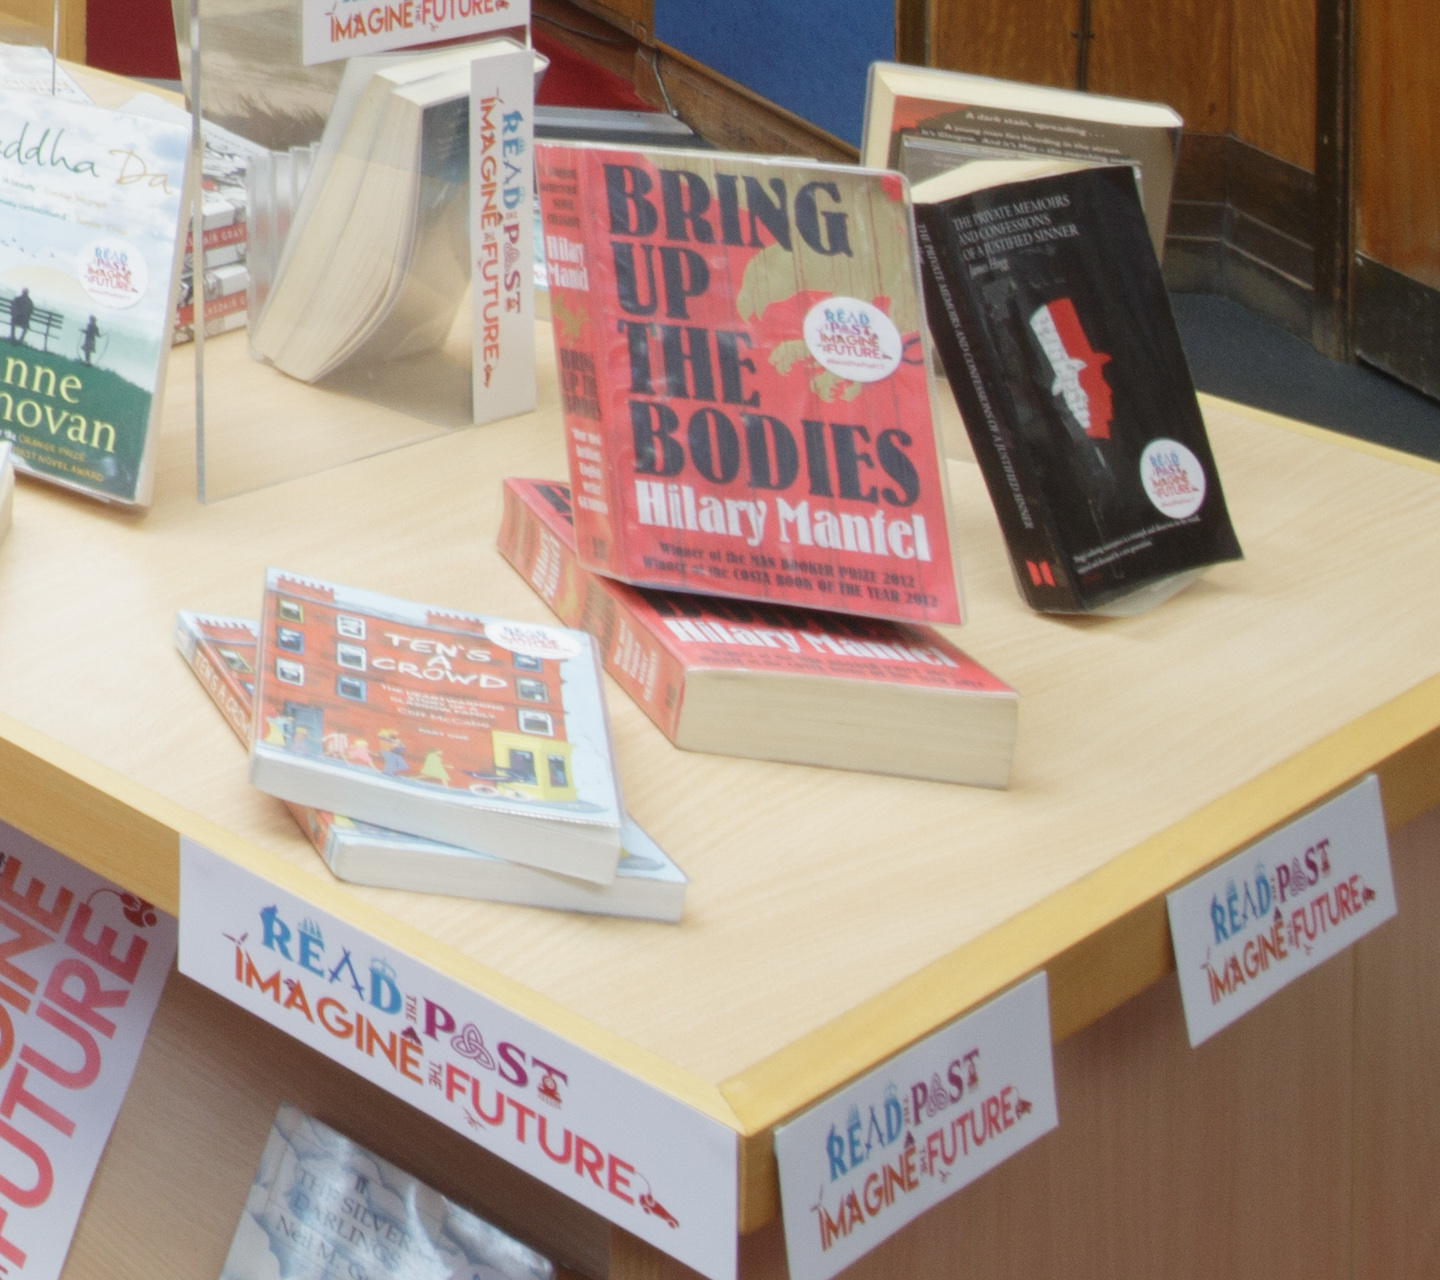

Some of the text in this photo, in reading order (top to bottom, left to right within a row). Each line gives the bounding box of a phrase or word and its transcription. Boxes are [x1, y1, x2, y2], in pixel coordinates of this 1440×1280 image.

[329, 0, 415, 44] IMAGINE
[109, 149, 172, 195] Da
[602, 162, 854, 259] BRING
[953, 194, 1071, 231] THE PRIVATE MEMOIRS
[610, 240, 711, 320] UP
[616, 319, 761, 409] THE
[629, 399, 921, 509] BODIES
[634, 479, 931, 562] Hilary Mantel
[371, 656, 509, 690] CROWD
[380, 631, 492, 665] TEN'S
[427, 650, 454, 669] A
[259, 906, 404, 1018] READ
[234, 942, 636, 1208] IMAGINE FUTURE
